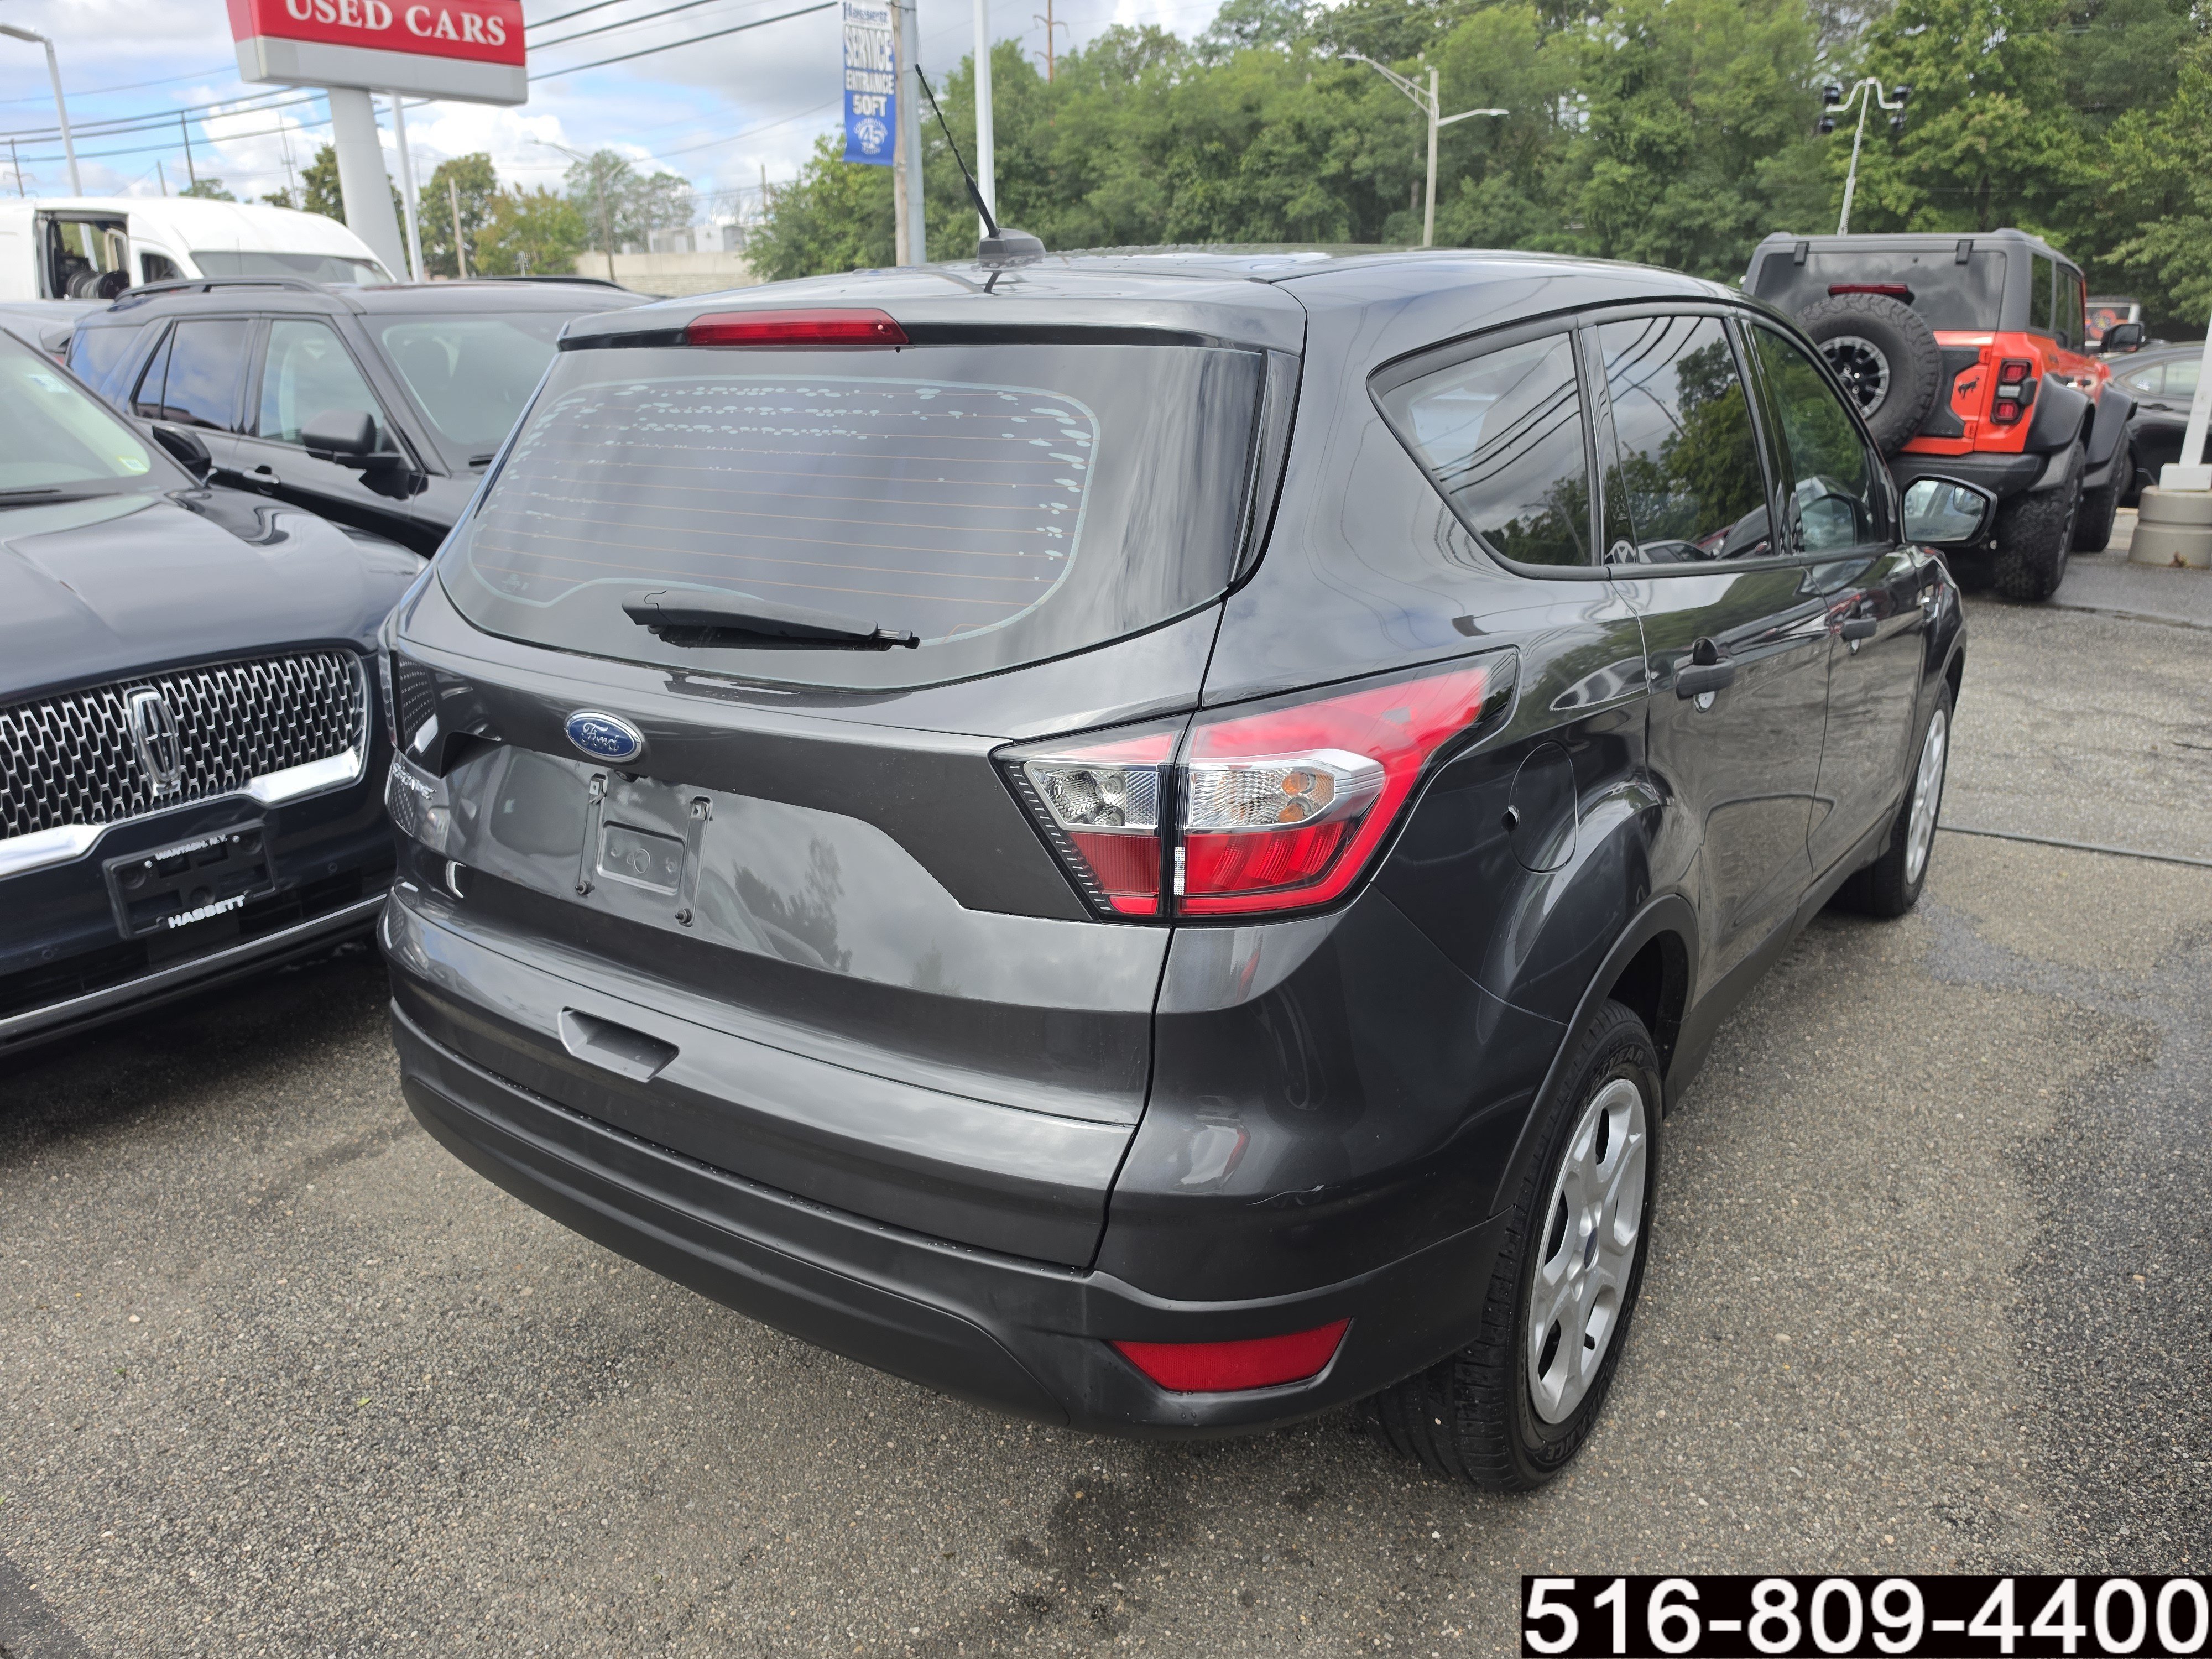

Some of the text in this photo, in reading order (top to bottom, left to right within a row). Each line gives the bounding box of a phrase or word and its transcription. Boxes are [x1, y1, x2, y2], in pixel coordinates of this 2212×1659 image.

[285, 0, 507, 46] USED CARS
[843, 24, 893, 72] SERVICE
[846, 70, 895, 95] ENTRANCE
[853, 94, 887, 117] 50FT
[581, 722, 619, 752] Ford
[168, 894, 246, 928] HASSETT
